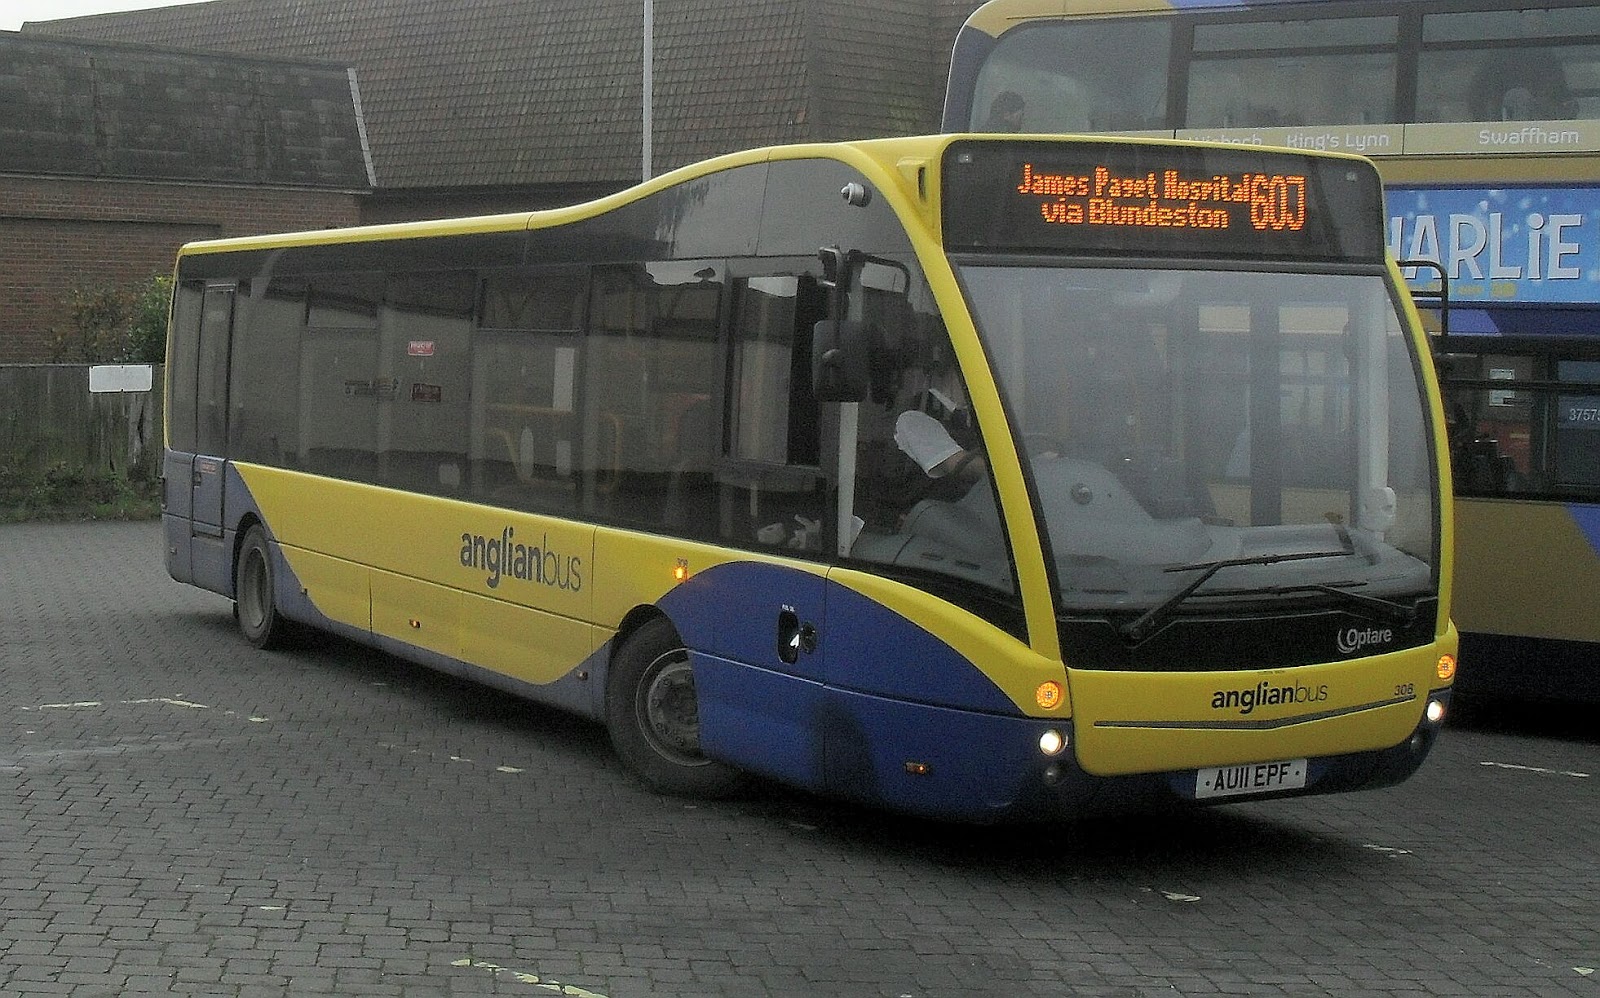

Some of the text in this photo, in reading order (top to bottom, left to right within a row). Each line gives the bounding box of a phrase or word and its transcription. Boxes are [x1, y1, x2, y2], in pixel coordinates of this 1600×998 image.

[1287, 132, 1391, 150] King's Lynn
[1479, 127, 1580, 145] Swaffham
[1017, 163, 1090, 196] James
[1041, 197, 1229, 229] via Blundeston
[460, 525, 582, 592] anglianbus
[1338, 627, 1393, 653] Optare
[1211, 679, 1328, 715] anglianbus
[1213, 763, 1292, 791] AU11 EPF
